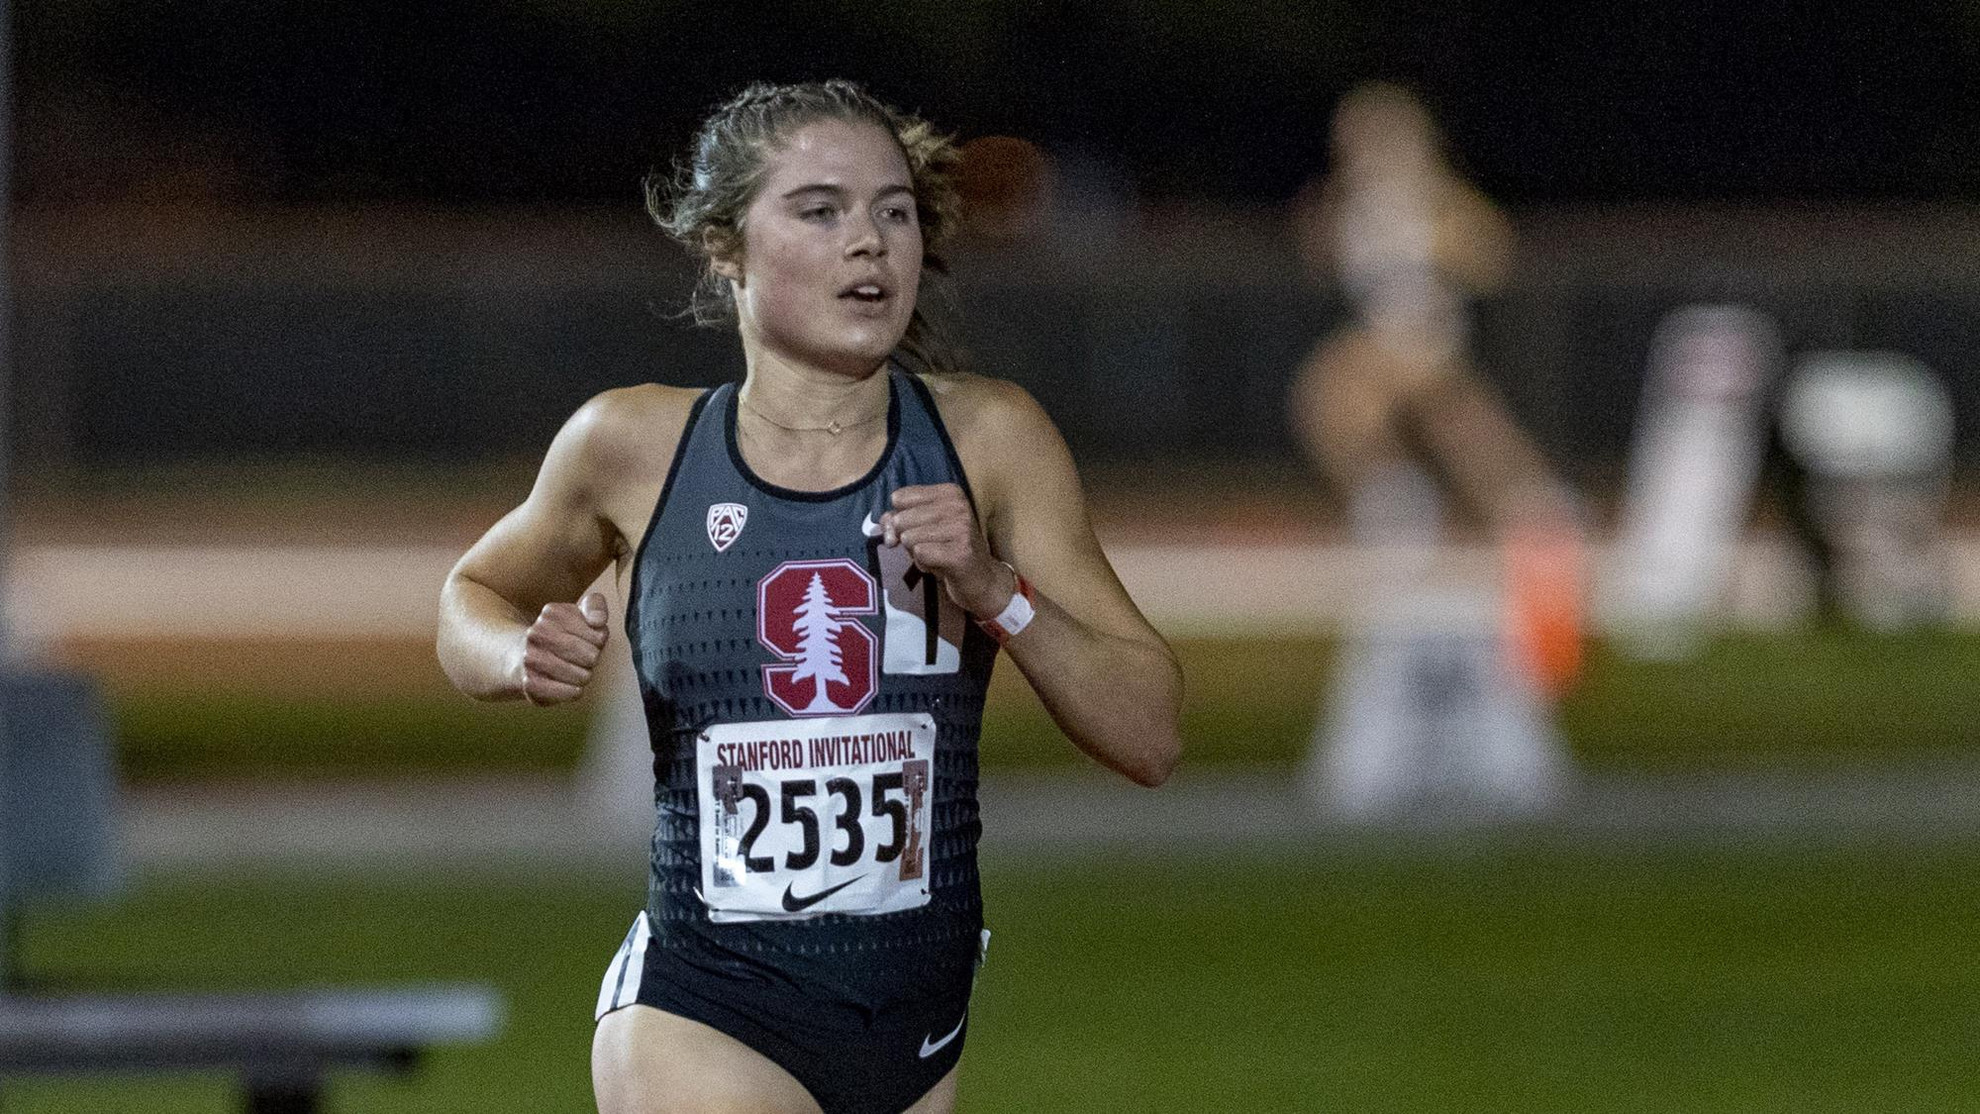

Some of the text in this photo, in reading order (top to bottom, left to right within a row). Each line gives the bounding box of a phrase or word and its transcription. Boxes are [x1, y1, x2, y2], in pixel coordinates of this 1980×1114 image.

[710, 505, 747, 532] PAC
[713, 523, 734, 541] 12
[716, 730, 916, 772] STANFORD INVITATIONAL
[736, 771, 908, 873] 2535
